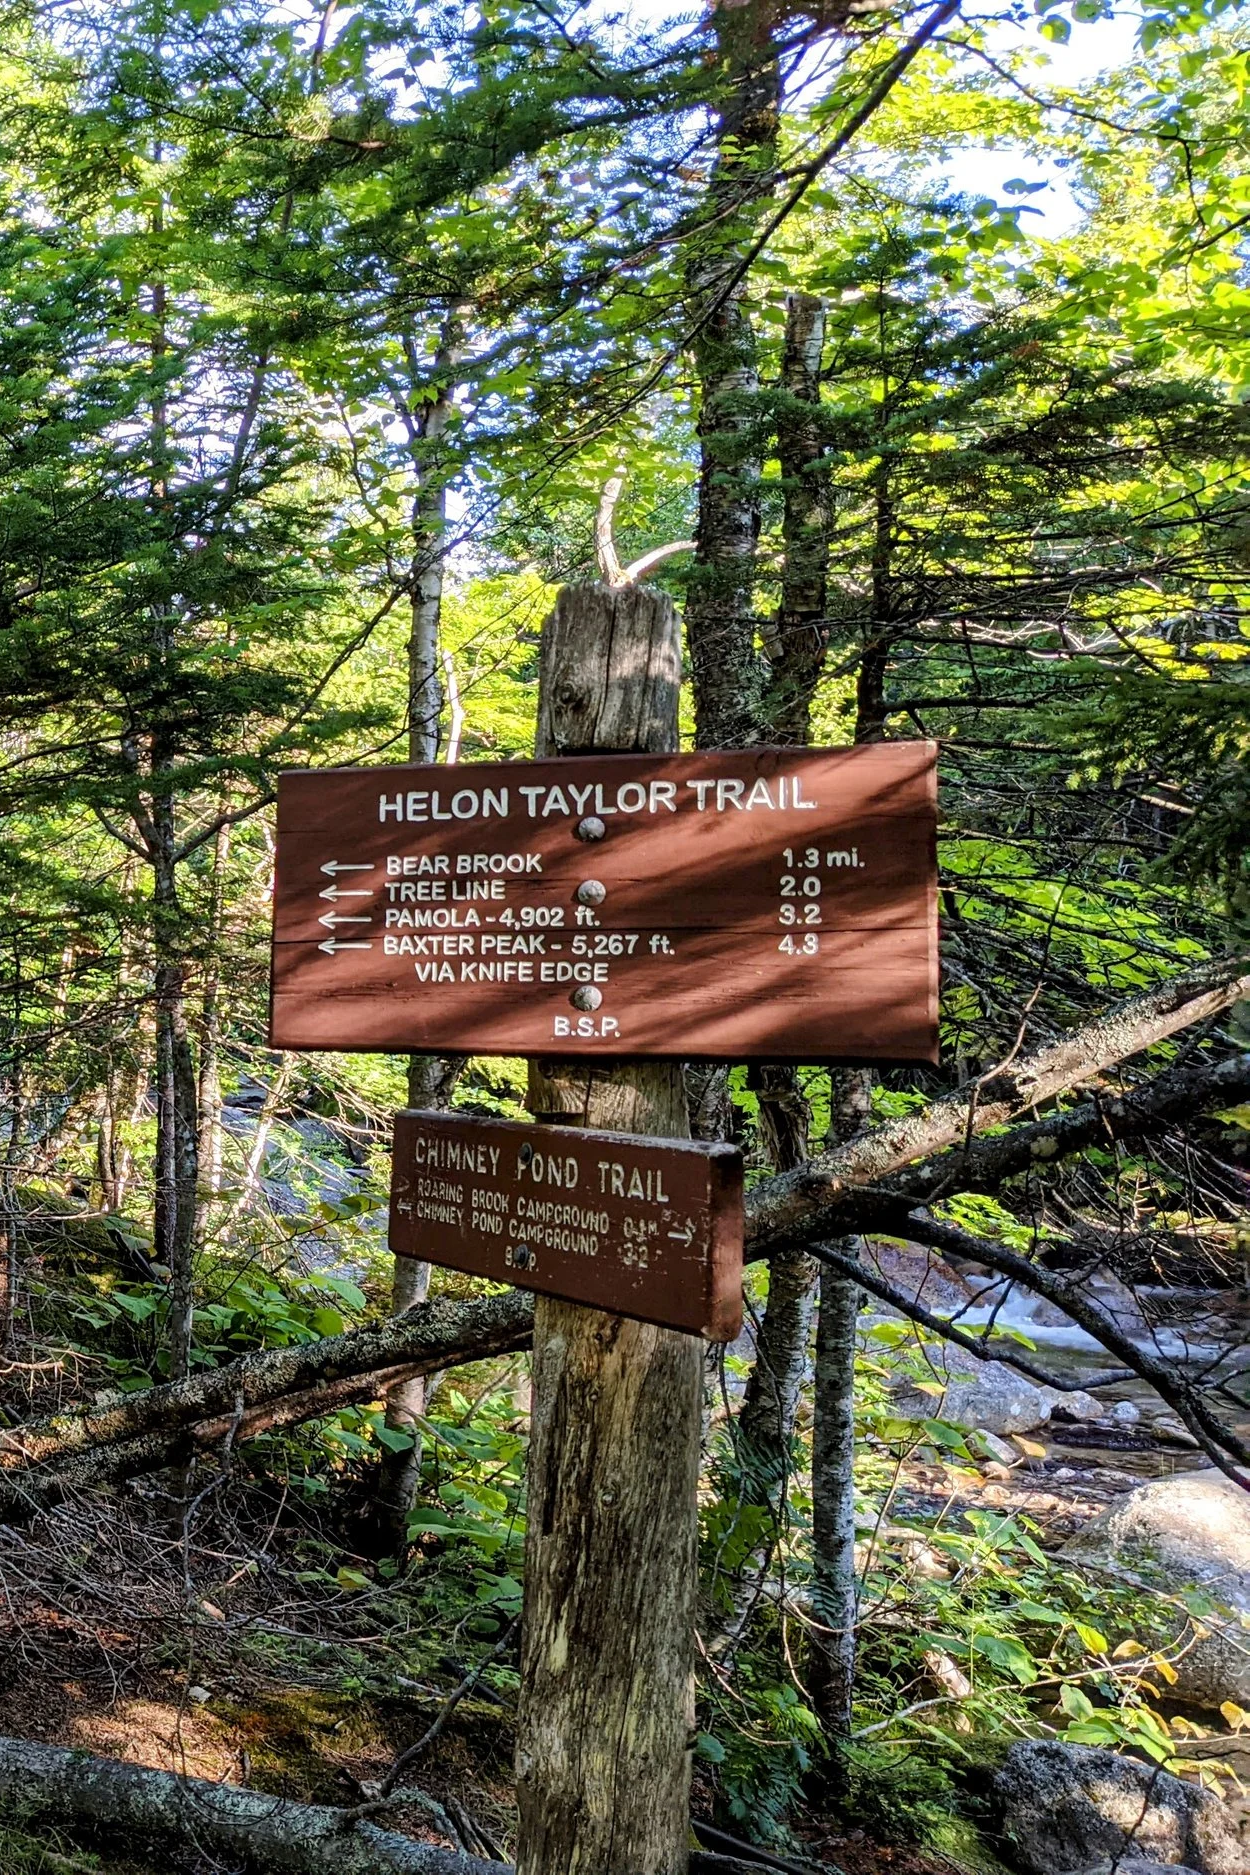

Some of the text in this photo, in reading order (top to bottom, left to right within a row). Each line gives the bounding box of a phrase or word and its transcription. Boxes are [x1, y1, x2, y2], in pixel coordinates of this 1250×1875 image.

[379, 776, 817, 822] HELON TAYLOR TRAIL
[386, 847, 866, 876] BEAR BROOK 1.3 mi.
[384, 876, 821, 902] TREE LINE 2.0
[385, 907, 481, 928] PAMOLA
[575, 906, 600, 927] ft.
[779, 904, 822, 925] 3.2
[383, 935, 474, 955] BAXTER
[481, 935, 546, 955] PEAK
[571, 934, 639, 958] 5,267
[649, 934, 675, 956] ft.
[778, 934, 819, 955] 4.3
[414, 962, 609, 983] VIA KNIFE EDGE
[554, 1016, 621, 1038] B.S.P.
[415, 1137, 500, 1176] CHIMNEY
[598, 1161, 669, 1202] TRAIL
[417, 1178, 464, 1203] ROARING
[472, 1189, 510, 1214] BROOK
[517, 1196, 610, 1234] CAMPGROUND
[417, 1201, 464, 1226] CHIMNEY
[472, 1211, 503, 1235] POND
[509, 1219, 598, 1256] CAMPGROUND
